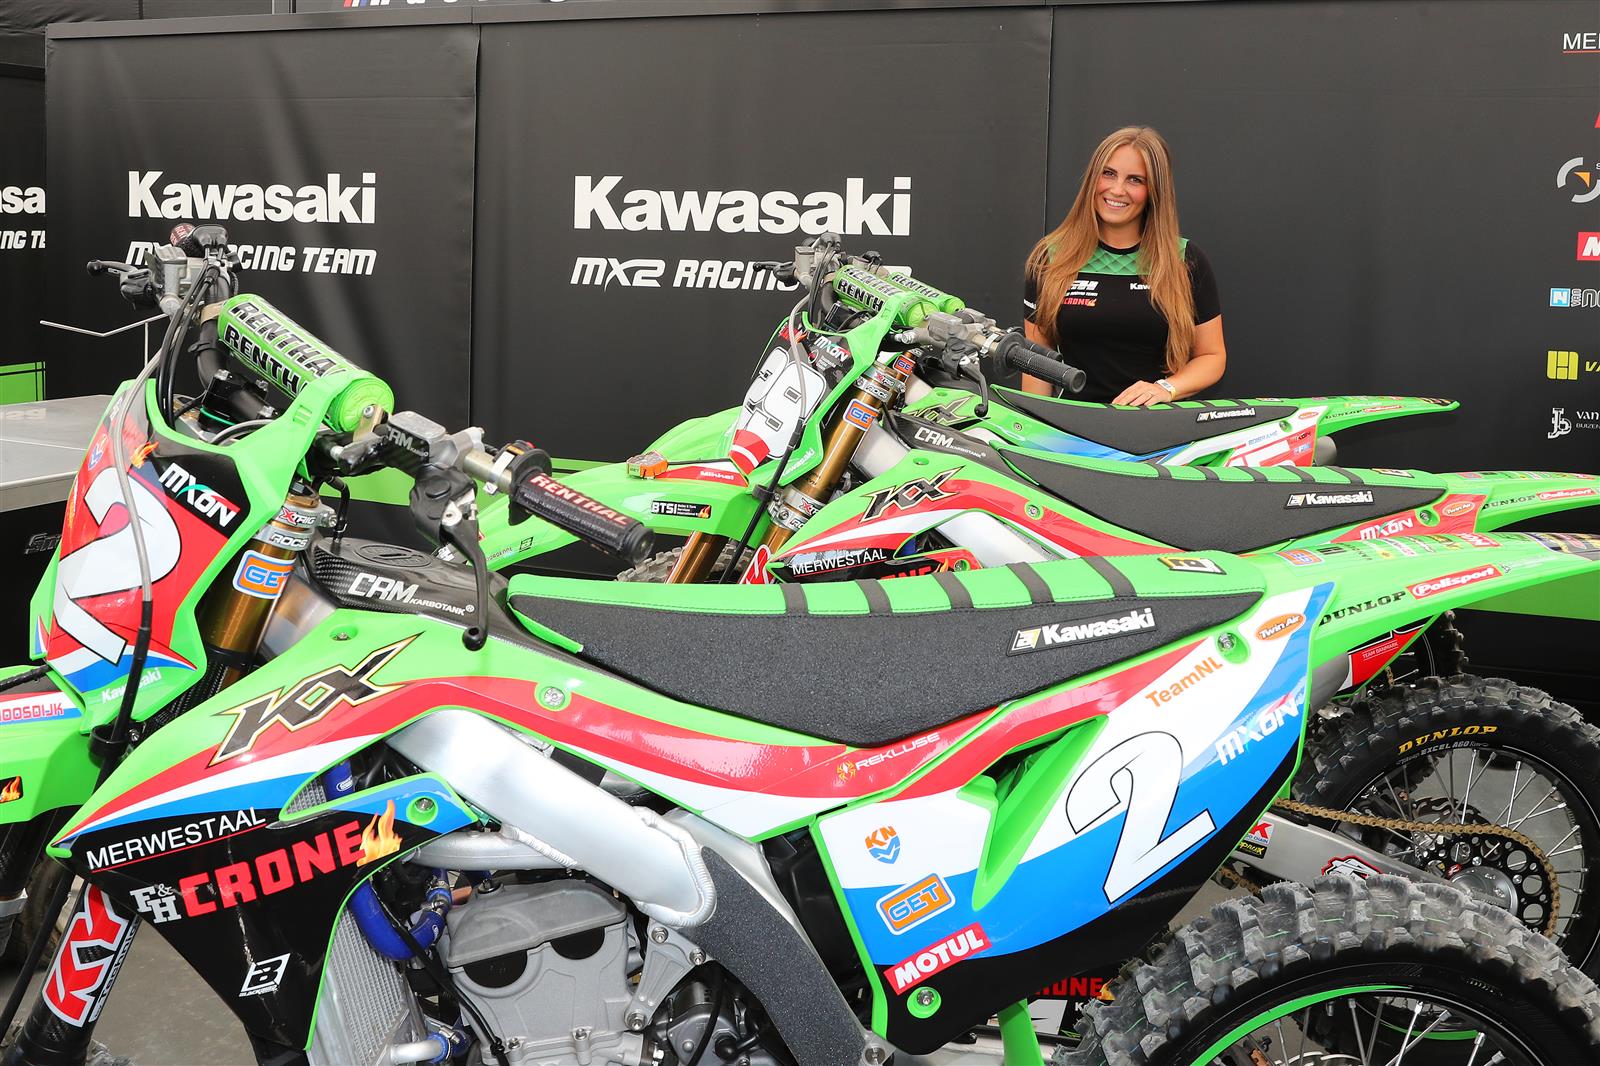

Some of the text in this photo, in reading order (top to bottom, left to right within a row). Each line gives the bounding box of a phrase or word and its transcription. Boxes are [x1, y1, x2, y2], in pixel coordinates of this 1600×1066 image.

[129, 171, 376, 223] Kawasaki
[573, 175, 912, 236] Kawasaki
[302, 247, 377, 275] TEAM
[570, 257, 666, 292] MX2
[838, 280, 886, 312] RENTH
[224, 323, 309, 394] RENTH
[1210, 407, 1256, 420] Kawasaki
[914, 426, 954, 449] CRM
[158, 462, 241, 528] MXON
[530, 475, 630, 526] RENTHAL
[859, 466, 965, 523] KX
[1306, 491, 1374, 505] Kawasaki
[1360, 517, 1414, 540] MXON
[52, 467, 182, 667] 2
[793, 548, 887, 576] MERWESTAAL
[348, 572, 419, 604] CRM
[1414, 566, 1496, 598] Polisport
[1042, 607, 1156, 646] Kawasaki
[1259, 614, 1301, 639] Twin Air
[1319, 591, 1407, 627] DUNLOP
[207, 631, 426, 768] KX
[1145, 656, 1223, 708] TeamNL
[0, 703, 63, 721] OOSDIJK
[1215, 696, 1301, 767] MXON
[855, 732, 941, 771] REKLUSE
[1399, 725, 1498, 755] DUNLOP
[1066, 731, 1217, 904] 2
[86, 807, 266, 871] MERWESTAAL
[179, 821, 365, 918] CRONE
[889, 882, 940, 922] GET
[896, 929, 985, 989] MOTUL
